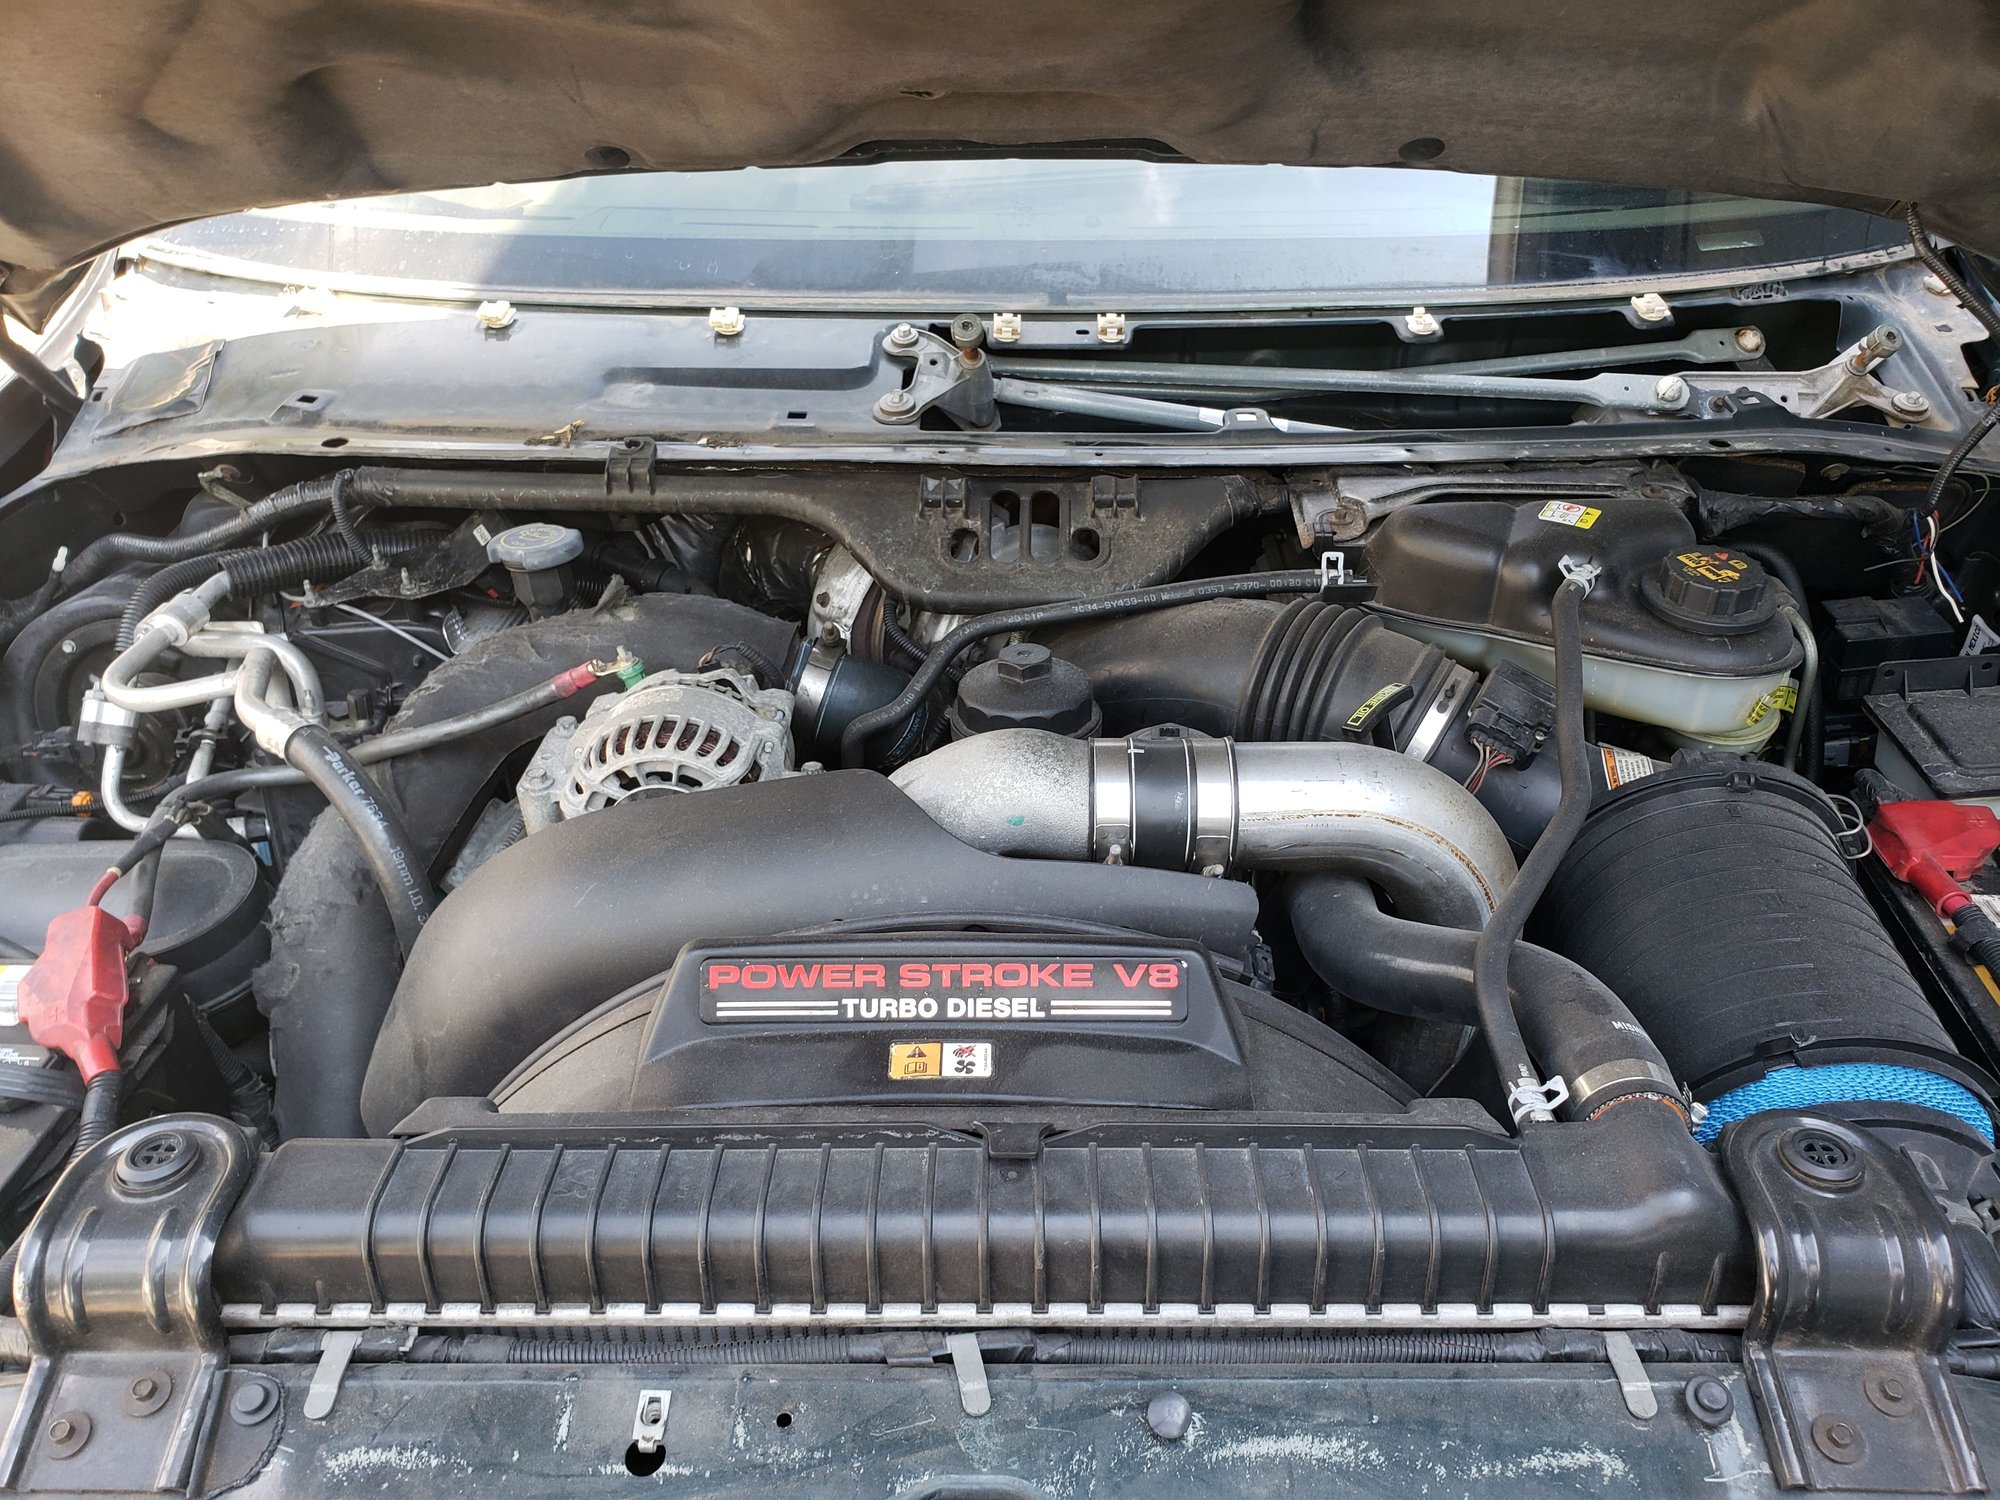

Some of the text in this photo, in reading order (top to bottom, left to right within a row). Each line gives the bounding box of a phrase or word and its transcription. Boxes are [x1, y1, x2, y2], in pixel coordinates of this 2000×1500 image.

[1354, 707, 1369, 718] OIL
[322, 745, 367, 798] Parker
[362, 796, 391, 831] 7634
[390, 845, 414, 887] 19mm
[408, 888, 424, 910] I.D.
[707, 962, 1180, 990] POWER STROKE V8
[841, 997, 1047, 1018] TURBO DIESEL
